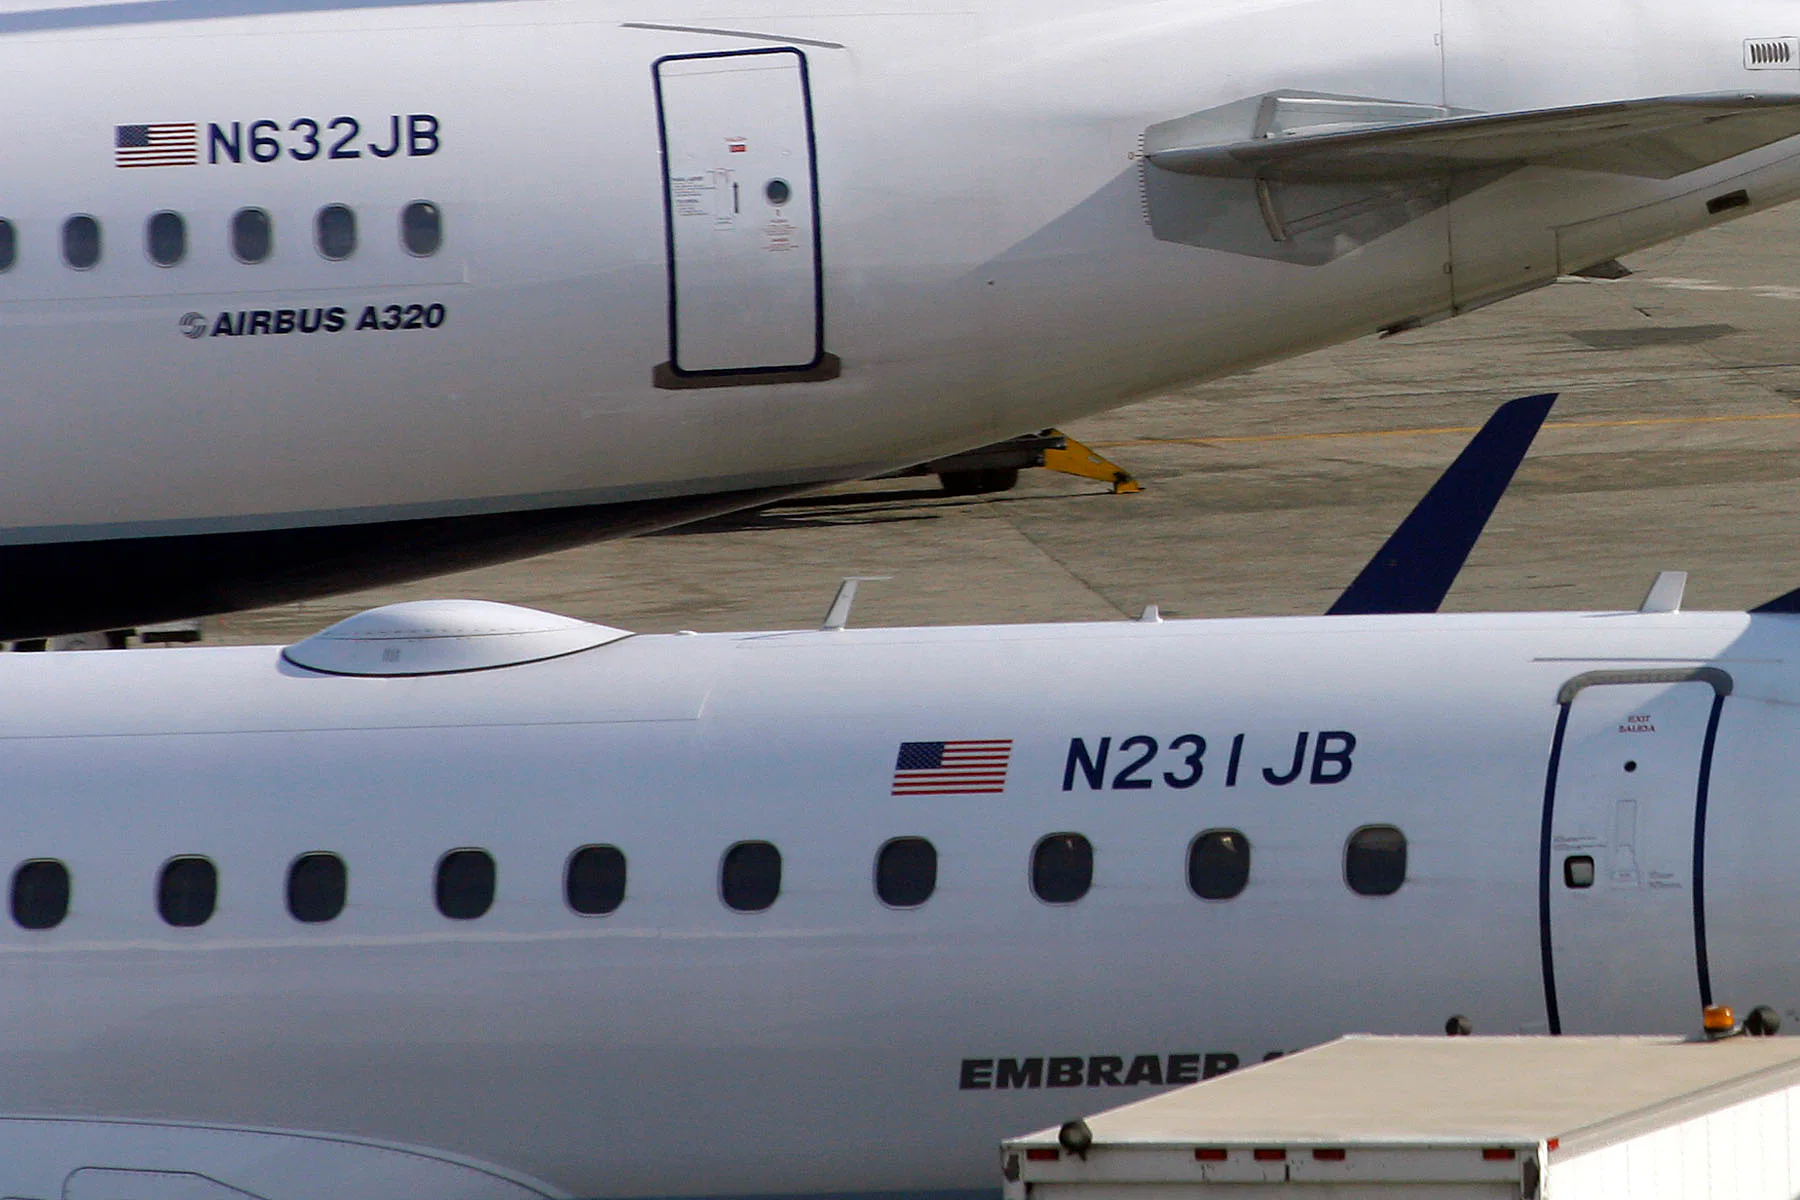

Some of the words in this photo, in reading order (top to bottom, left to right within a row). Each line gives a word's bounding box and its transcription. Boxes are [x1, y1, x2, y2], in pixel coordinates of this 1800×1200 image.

[207, 114, 440, 165] N632JB
[210, 307, 347, 337] AIRBUS
[355, 303, 447, 332] A320
[1062, 730, 1357, 791] N231JB
